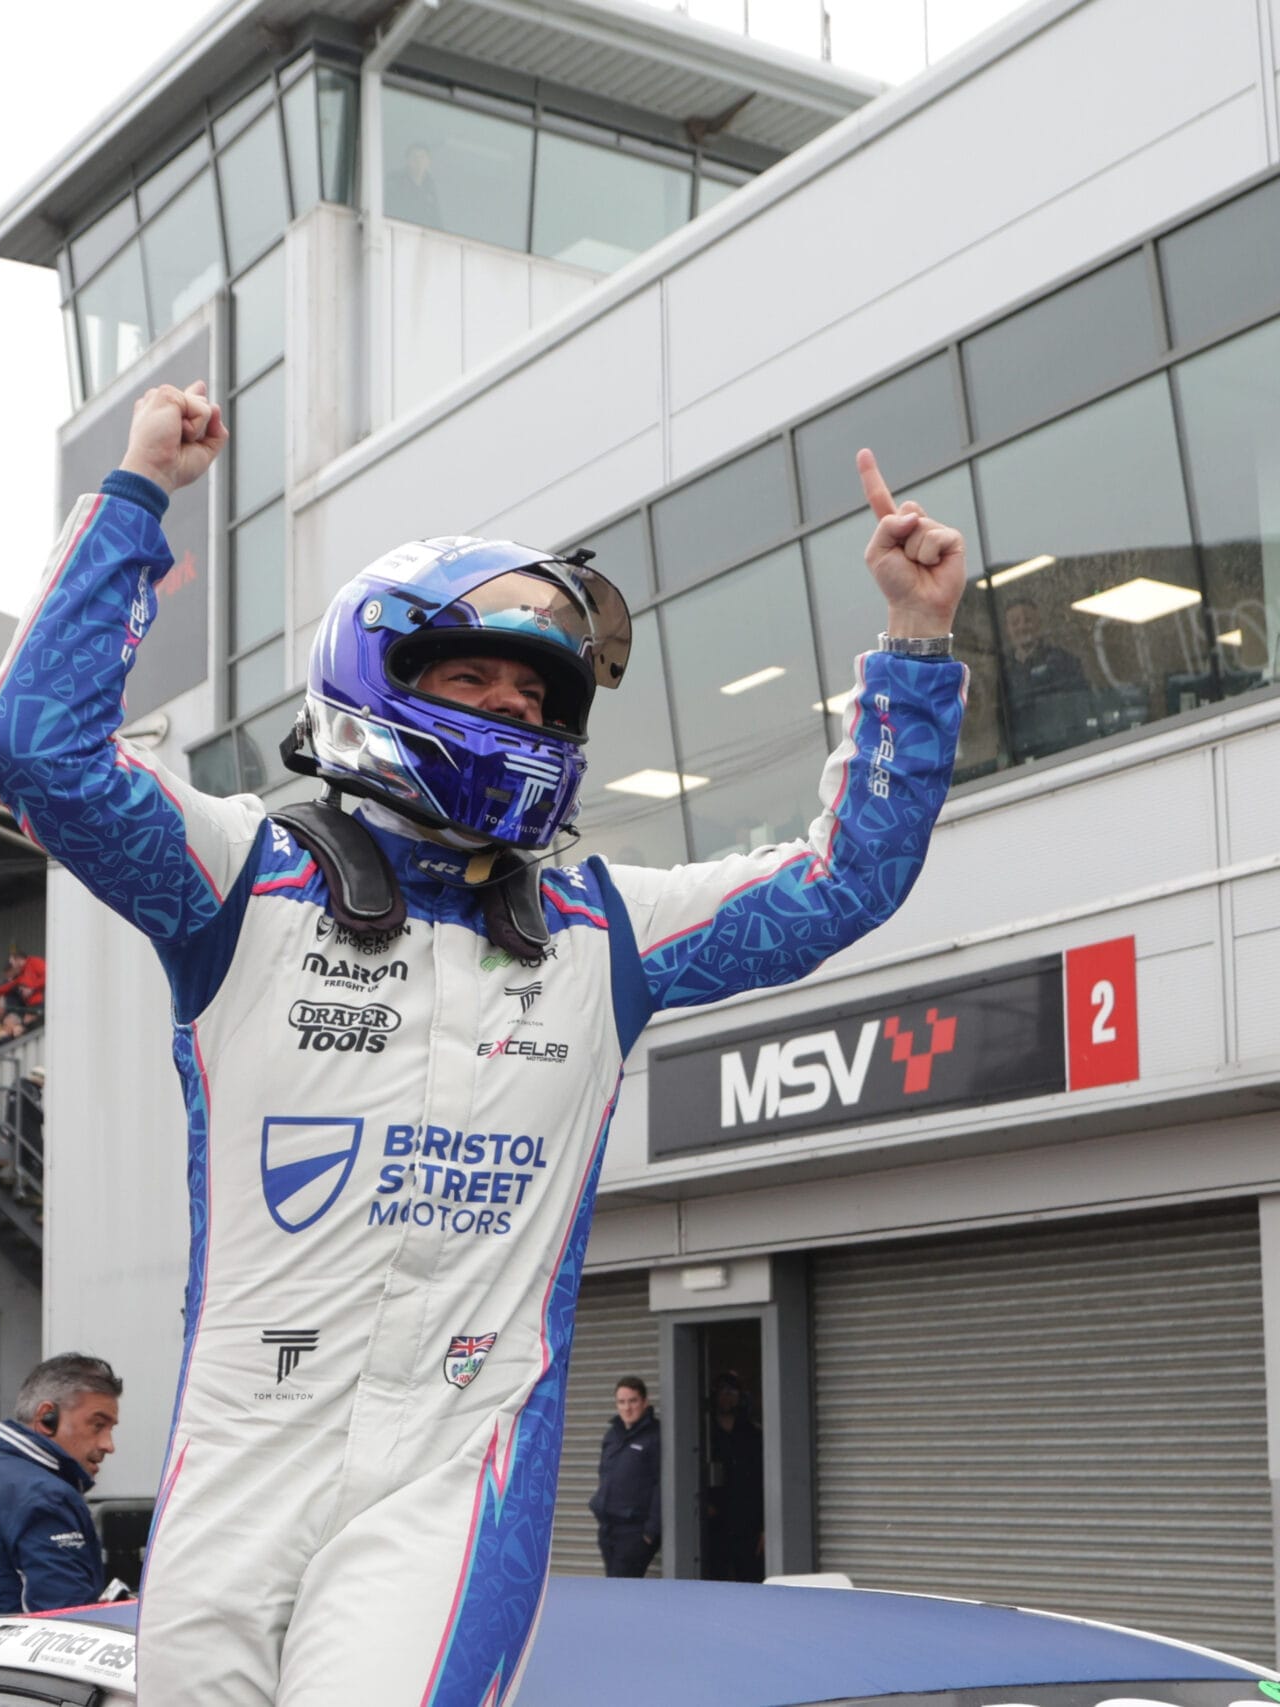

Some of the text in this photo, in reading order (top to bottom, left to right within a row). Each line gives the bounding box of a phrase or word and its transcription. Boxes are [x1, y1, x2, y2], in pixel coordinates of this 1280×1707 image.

[874, 693, 896, 799] EXCELR8
[324, 979, 365, 993] FREIGHT
[297, 1006, 389, 1028] DRAPER
[1090, 980, 1117, 1045] 2
[297, 1025, 388, 1053] Tools
[477, 1035, 568, 1059] EXCELR8
[721, 1019, 880, 1129] MSV
[383, 1124, 547, 1169] BRISTOL
[376, 1163, 533, 1205] STREET
[368, 1198, 511, 1235] MOTORS
[254, 1392, 314, 1401] TOM CHILTON
